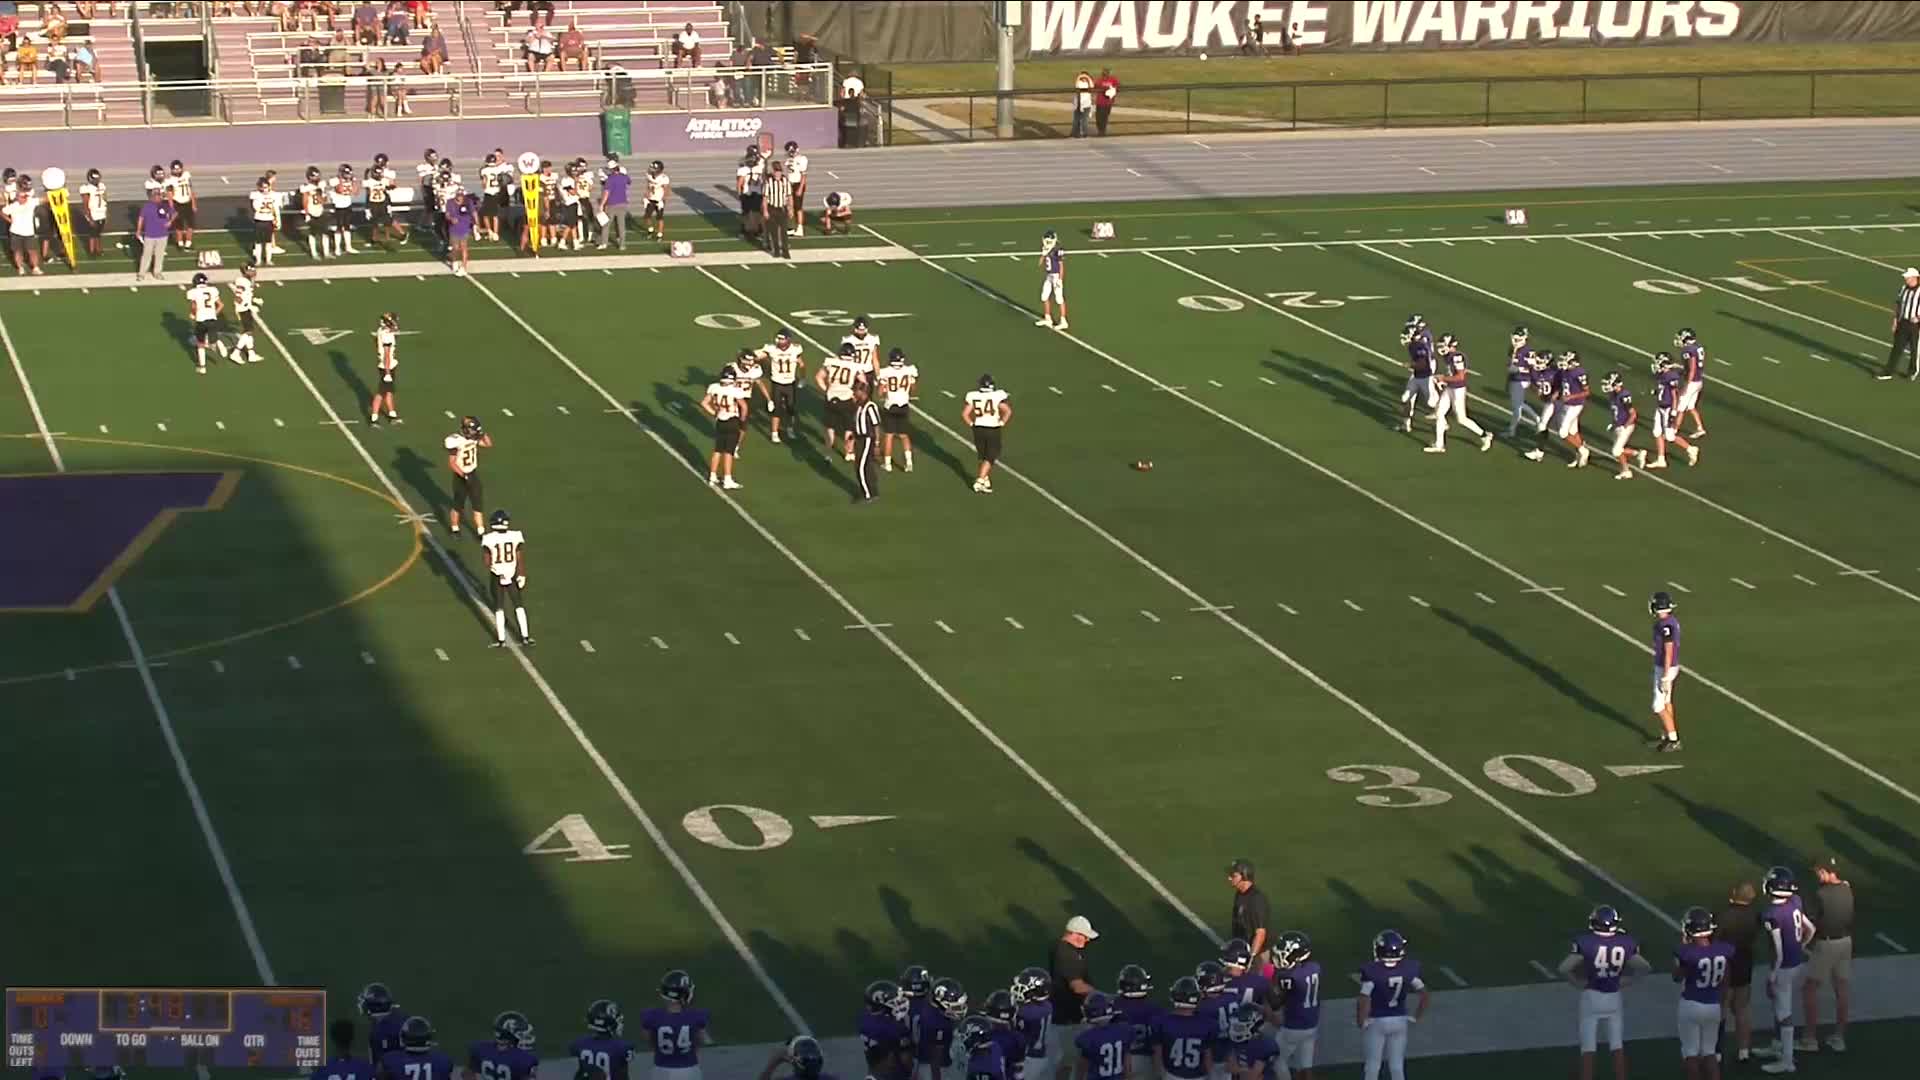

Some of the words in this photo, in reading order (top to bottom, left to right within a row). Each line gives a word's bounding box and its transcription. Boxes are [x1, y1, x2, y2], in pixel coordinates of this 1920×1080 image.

[1030, 1, 1328, 49] WAUKEE
[1352, 1, 1740, 43] WARRIORS
[203, 292, 212, 308] 2
[778, 358, 791, 374] 11
[831, 364, 851, 386] 70
[888, 374, 908, 392] 84
[494, 542, 514, 563] 18
[1594, 945, 1625, 978] 49
[1696, 956, 1727, 988] 38
[1303, 973, 1319, 1009] 17
[1388, 976, 1403, 1008] 7
[657, 1025, 692, 1054] 64
[1169, 1037, 1201, 1069] 45
[1100, 1039, 1123, 1077] 31
